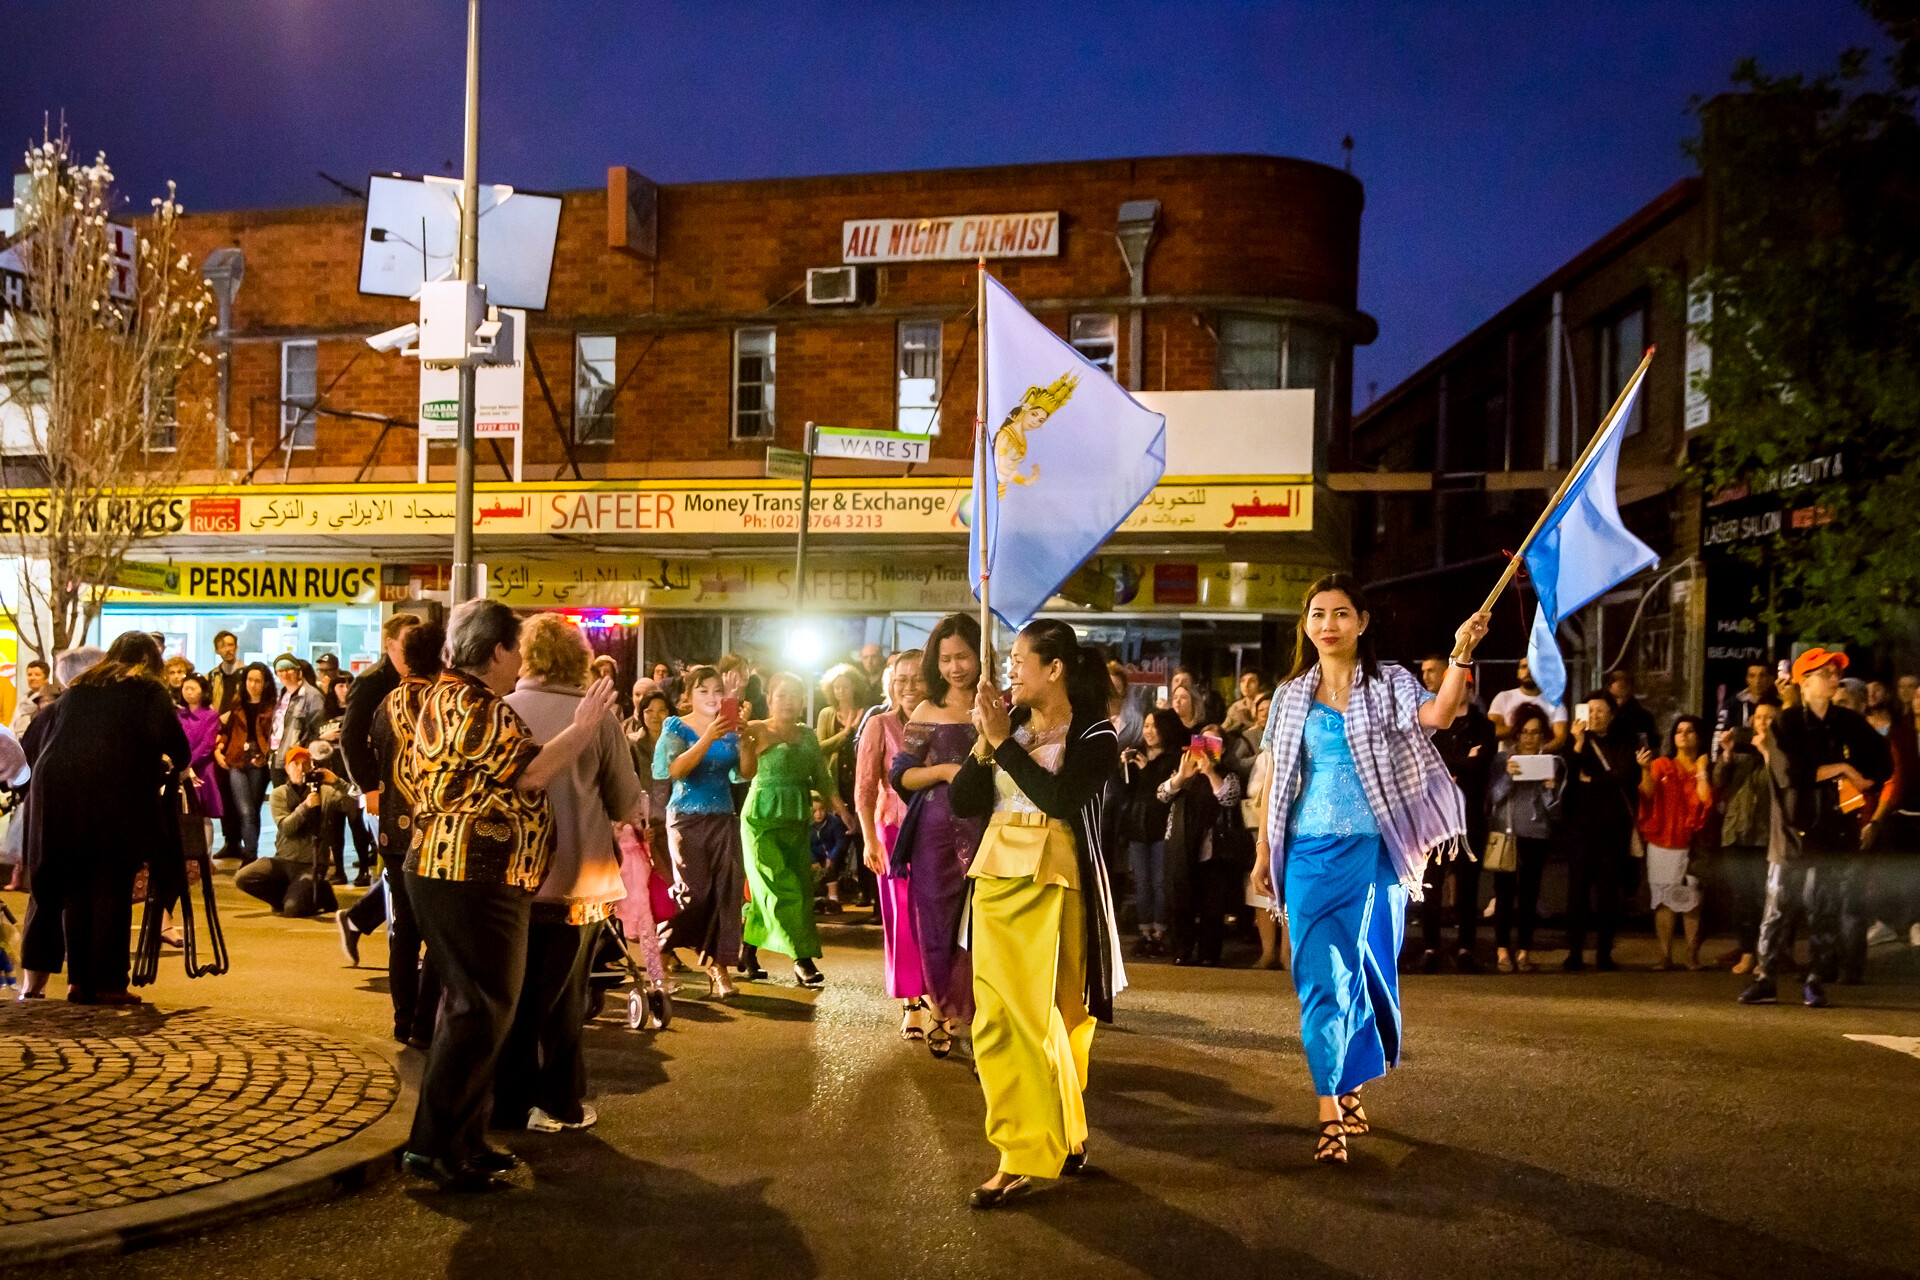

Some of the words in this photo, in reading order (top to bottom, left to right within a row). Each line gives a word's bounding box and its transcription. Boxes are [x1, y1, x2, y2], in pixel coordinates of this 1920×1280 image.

[845, 225, 880, 257] ALL
[888, 221, 953, 256] NIGHT
[959, 216, 1056, 252] CHEMIST
[841, 438, 896, 457] WARE
[901, 442, 924, 459] ST
[403, 499, 455, 524] سجاد
[473, 497, 531, 526] السفير
[551, 493, 675, 529] SAFEER
[685, 494, 749, 515] Money
[753, 493, 828, 511] Transer
[833, 492, 847, 511] &
[852, 491, 945, 515] Exchange
[1141, 488, 1206, 511] للتحويلا
[1224, 489, 1300, 528] السفير
[0, 500, 98, 533] ERSAN
[107, 499, 184, 532] RUGS
[194, 515, 237, 531] RUGS
[309, 509, 318, 527] و
[744, 514, 767, 528] Ph:
[771, 514, 799, 529] (02)
[846, 514, 883, 528] 3213
[190, 566, 297, 597] PERSIAN
[304, 566, 376, 598] RUGS
[489, 564, 529, 597] الترك
[881, 564, 932, 586] Money
[935, 564, 968, 581] Tran
[1707, 646, 1763, 659] BEAUTY
